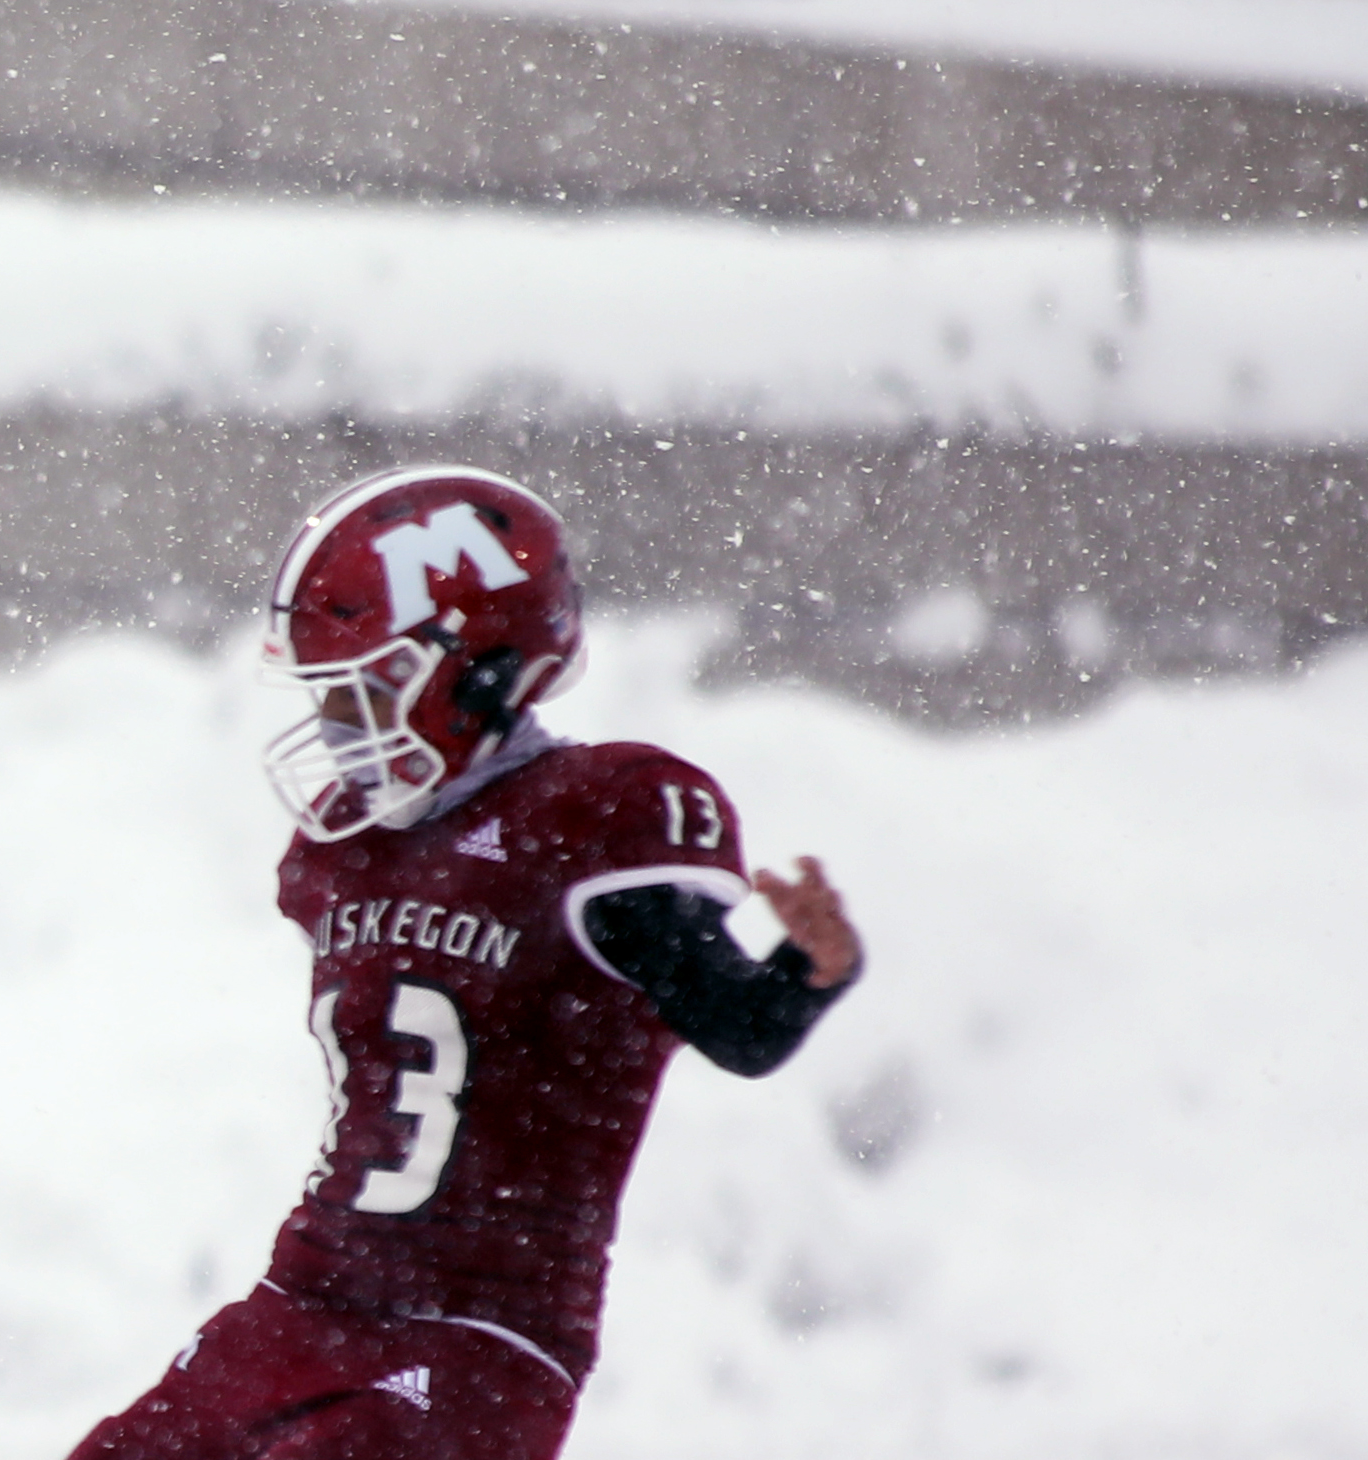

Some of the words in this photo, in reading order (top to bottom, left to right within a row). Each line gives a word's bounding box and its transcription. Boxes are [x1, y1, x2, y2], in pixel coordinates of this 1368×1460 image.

[372, 501, 532, 636] M
[661, 783, 723, 849] 13
[316, 896, 521, 969] USKEGON
[373, 1381, 433, 1411] adidas
